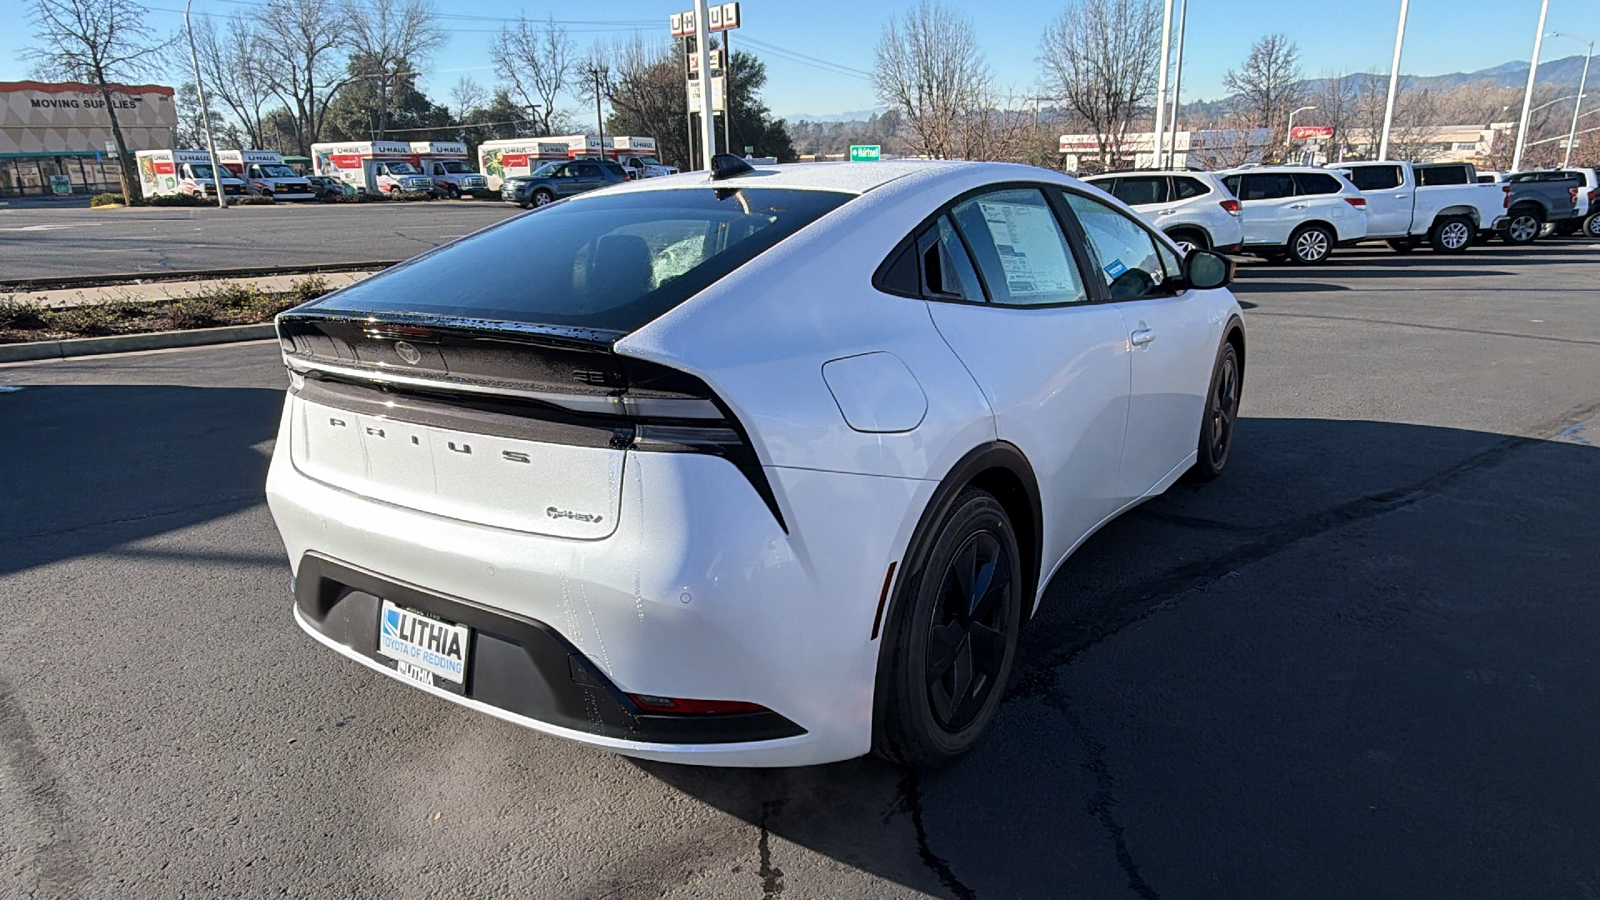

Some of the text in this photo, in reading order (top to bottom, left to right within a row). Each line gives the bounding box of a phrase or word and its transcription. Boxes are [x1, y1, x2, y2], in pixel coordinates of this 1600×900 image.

[671, 7, 733, 31] U-HUL
[31, 99, 137, 109] MOVING SUPLIES
[329, 417, 531, 464] PRIUS
[382, 636, 462, 674] TOYOTA OF REDDING
[399, 613, 462, 661] LITHIA
